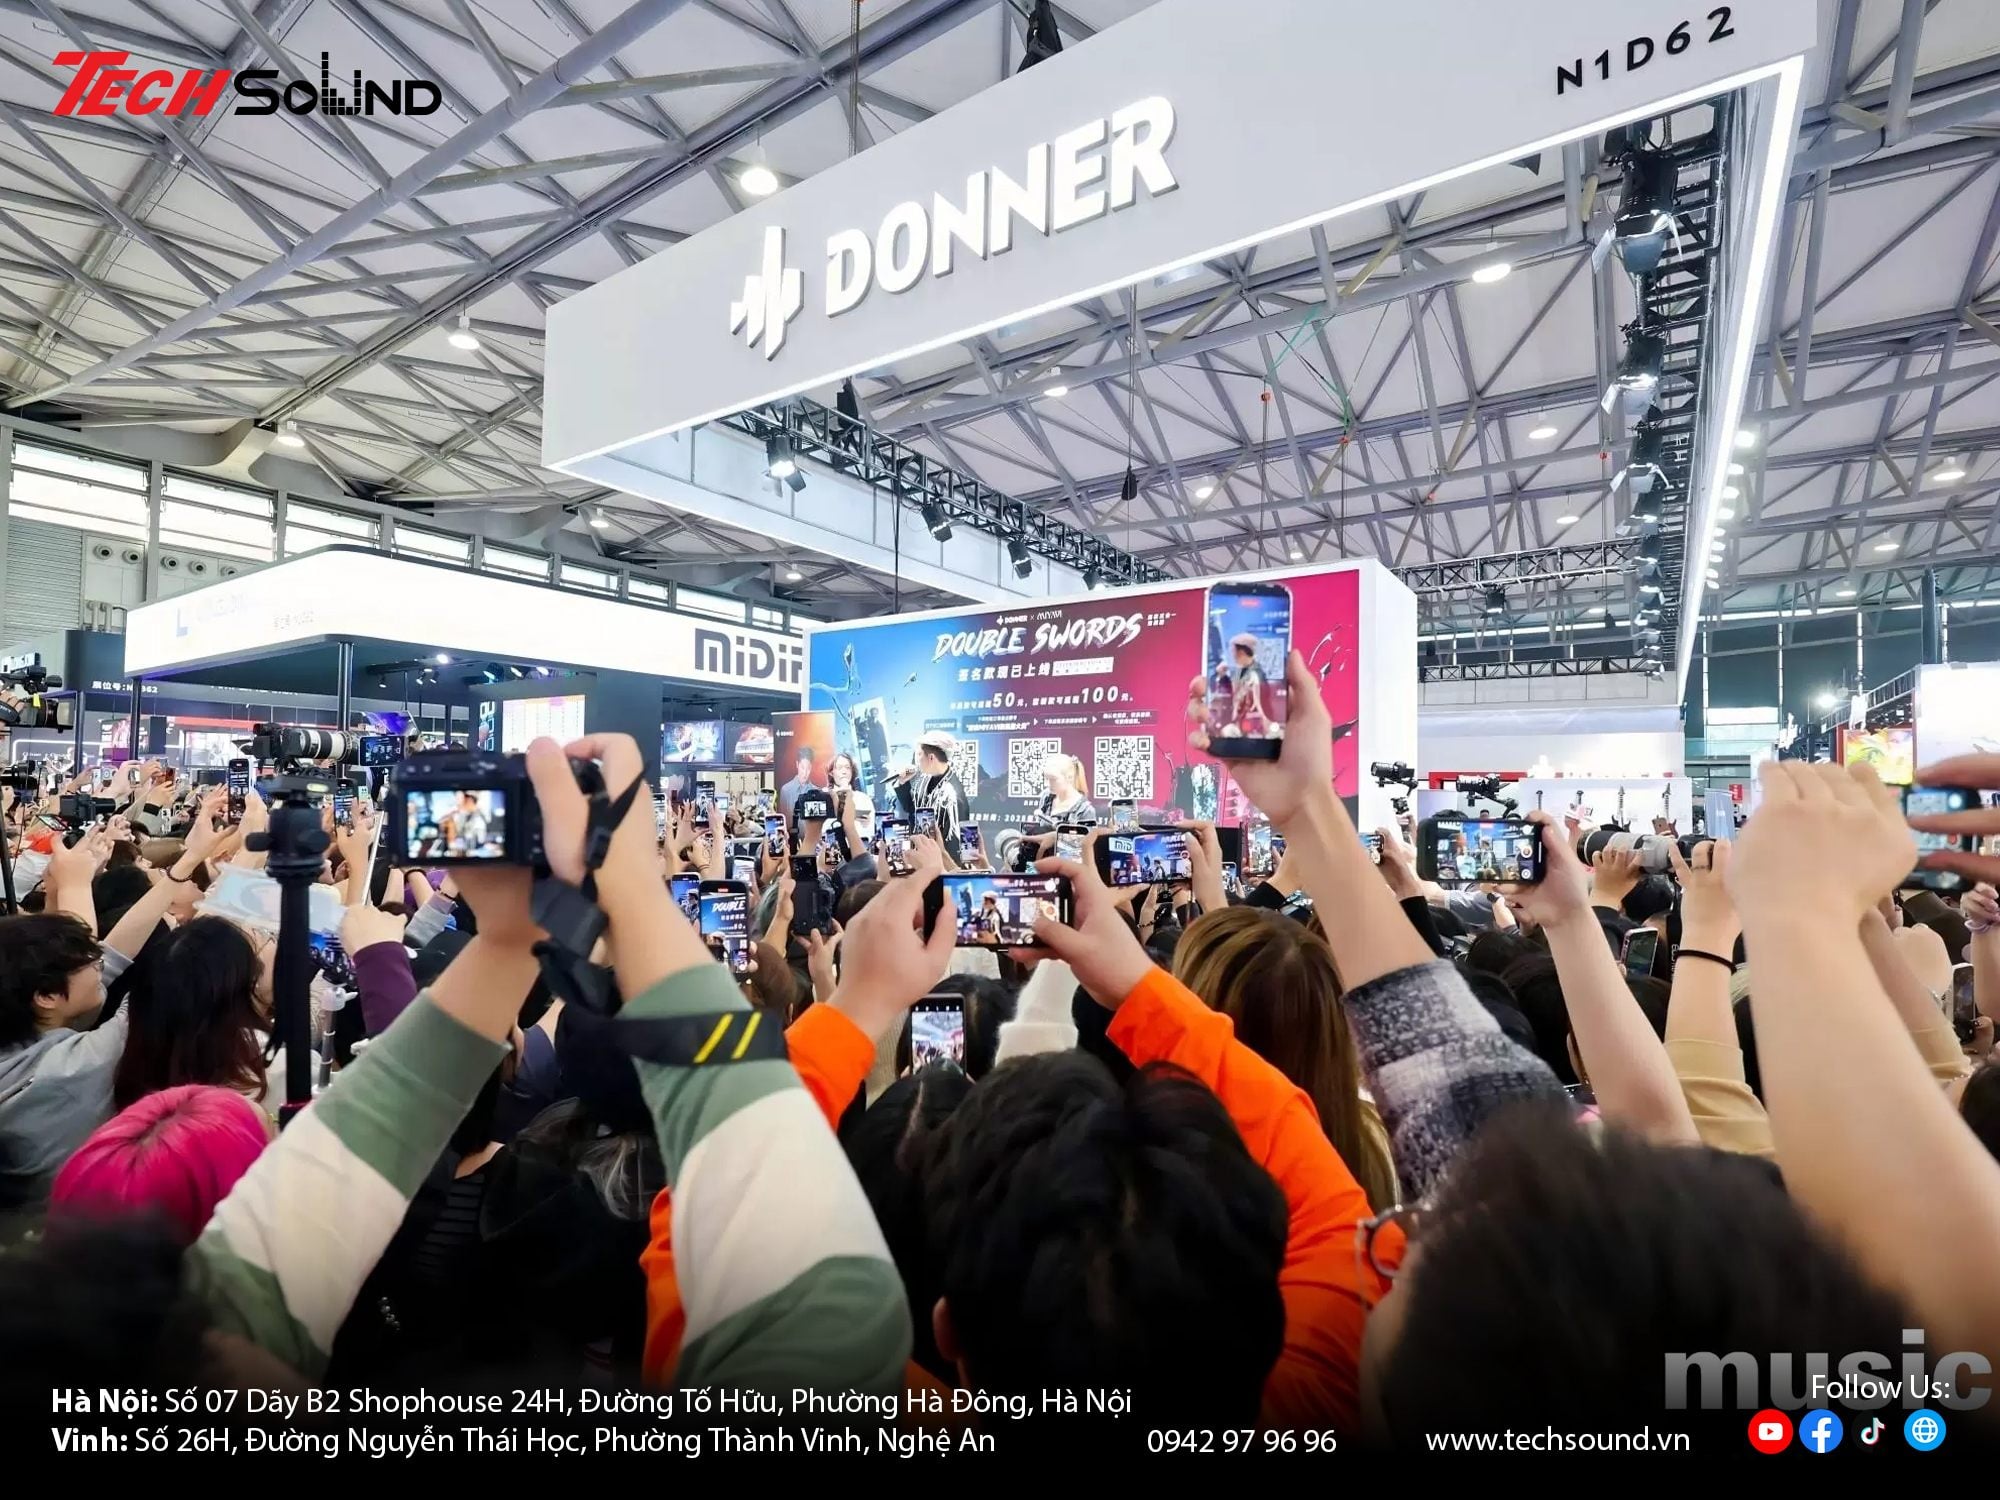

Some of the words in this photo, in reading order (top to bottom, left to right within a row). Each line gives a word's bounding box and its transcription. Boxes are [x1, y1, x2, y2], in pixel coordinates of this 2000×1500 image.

[1557, 6, 1735, 95] N1D62
[826, 96, 1178, 317] DONNER
[931, 626, 1027, 663] DOUBLE
[1031, 613, 1144, 655] SWORDS
